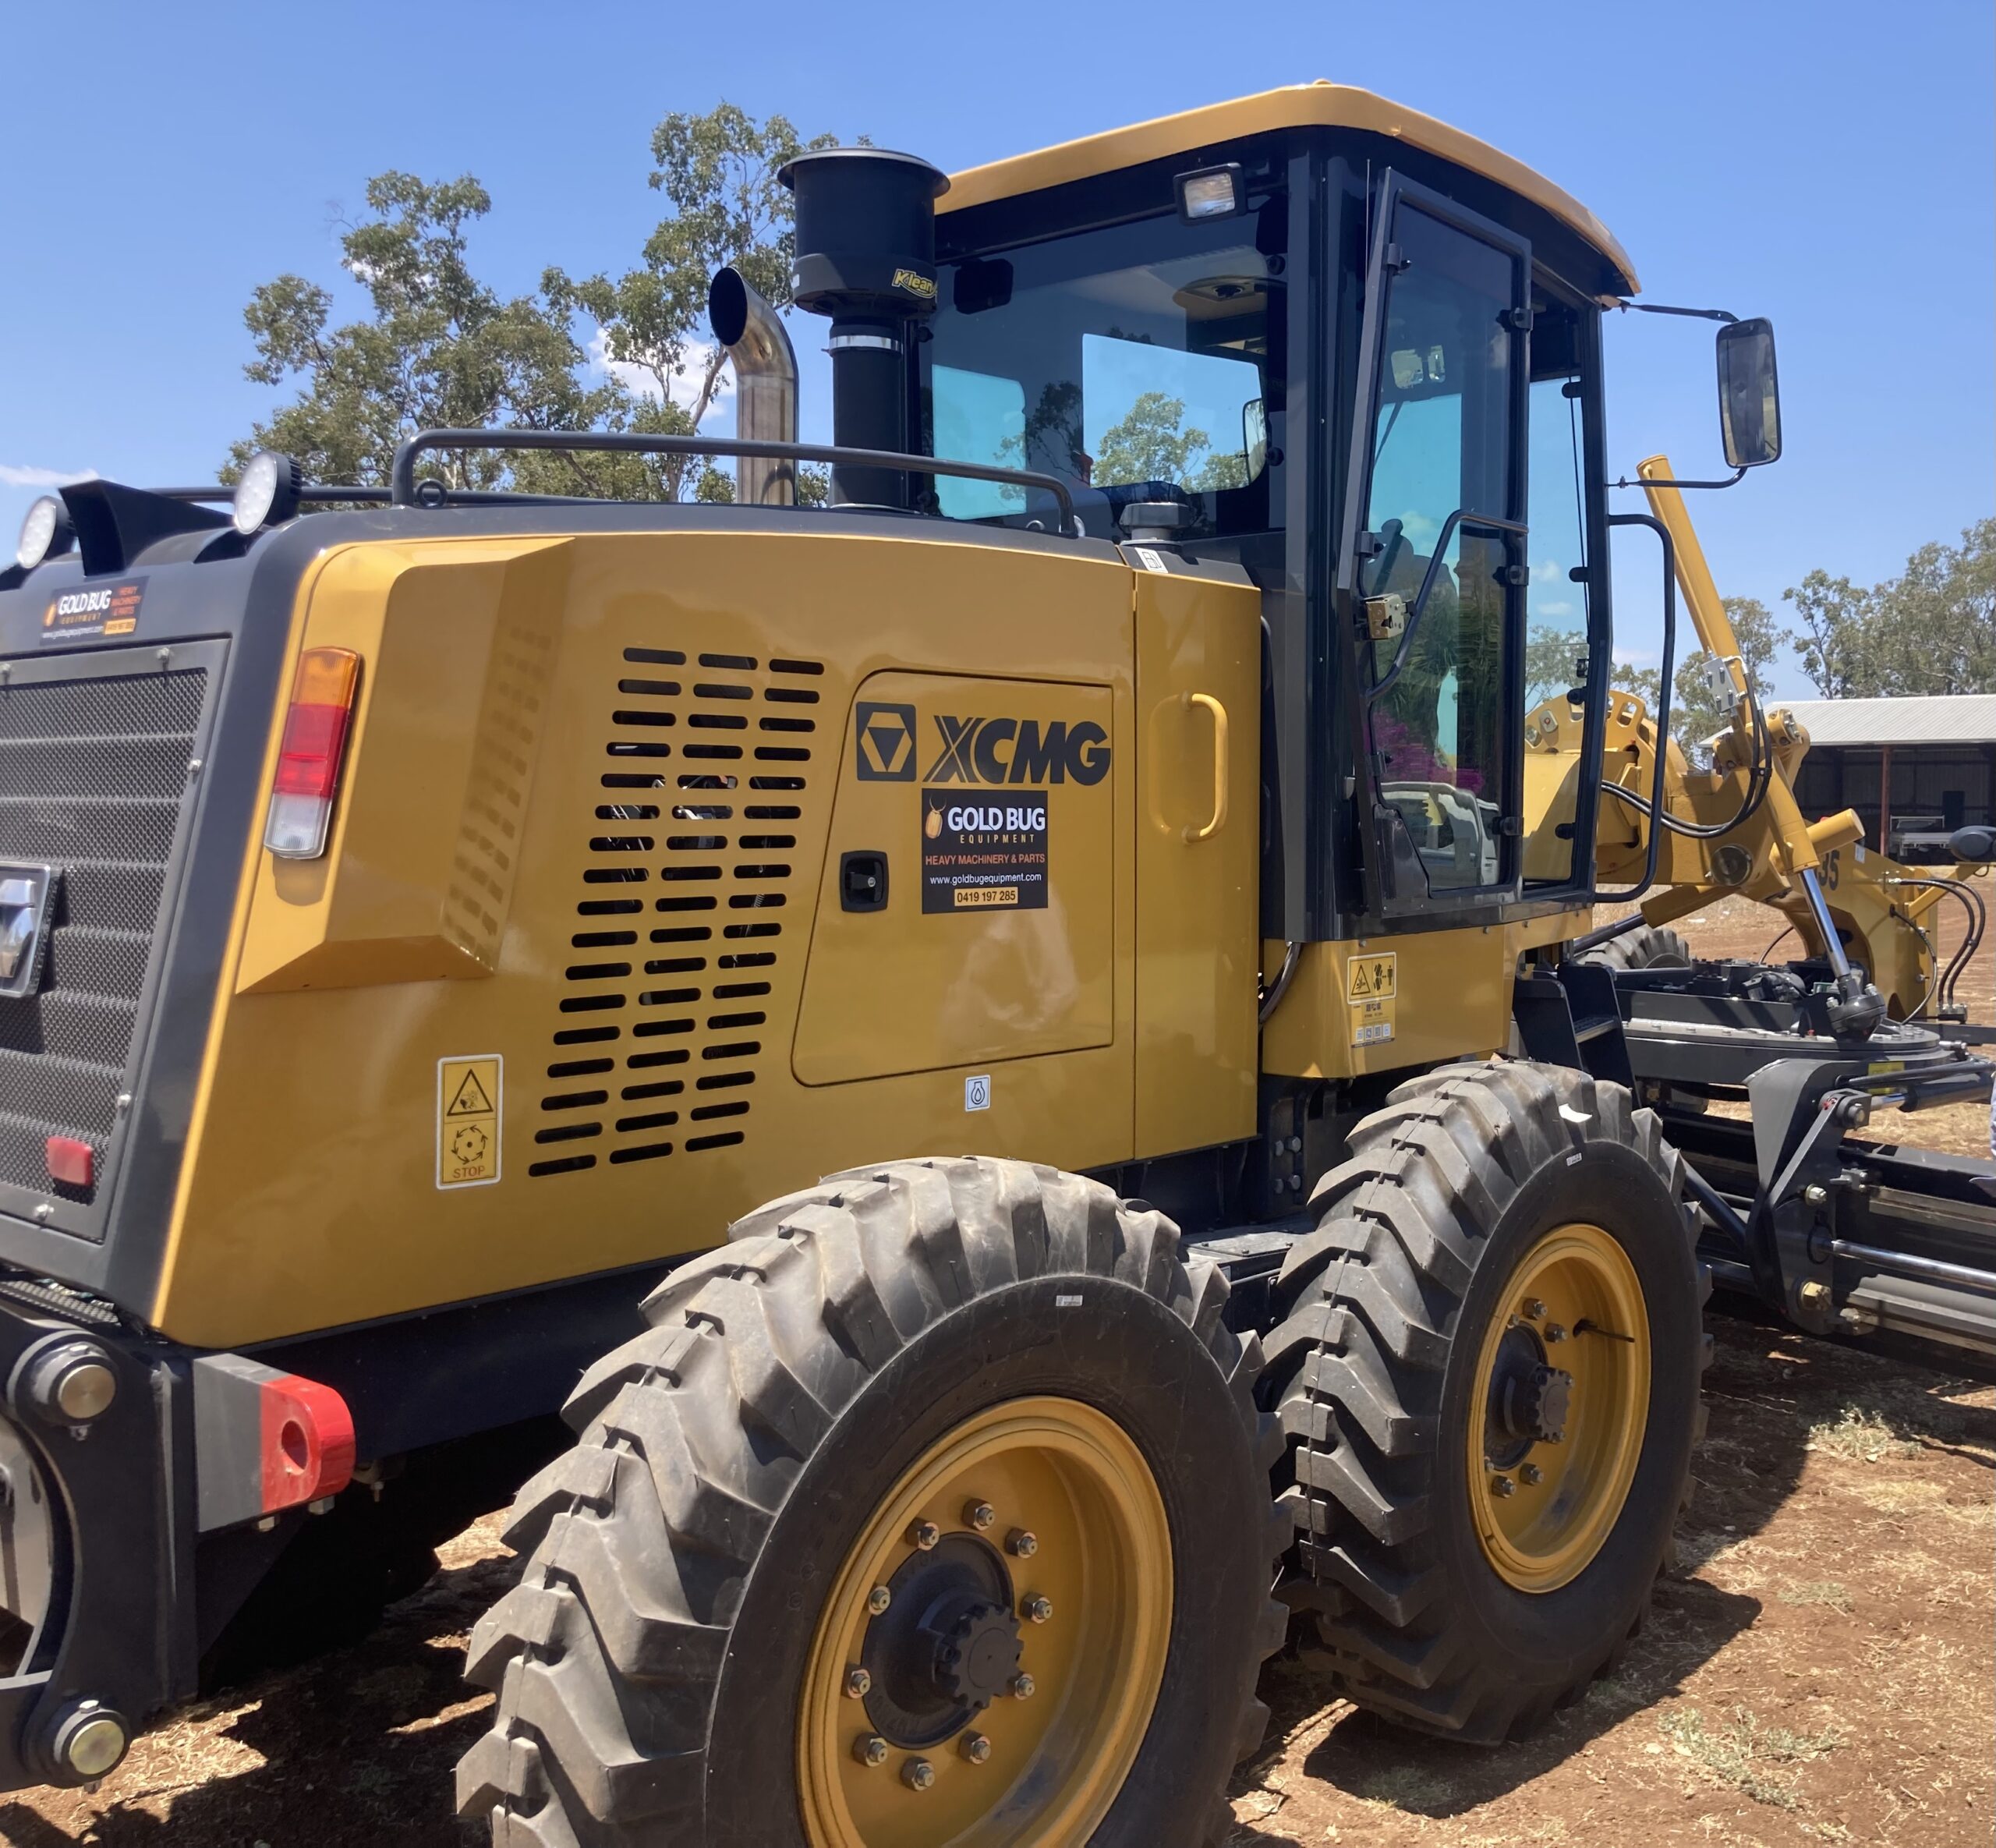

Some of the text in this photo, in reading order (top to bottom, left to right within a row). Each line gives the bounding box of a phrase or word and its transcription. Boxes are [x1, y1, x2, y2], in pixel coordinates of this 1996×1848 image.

[893, 269, 933, 293] Klean
[58, 589, 112, 615] GOLD BUG
[922, 715, 1111, 786] XCMG
[947, 807, 1046, 831] GOLD BUG
[960, 834, 1035, 844] EQUIPMENT
[925, 854, 1046, 866] HEAVY MACHINERY & PARTS
[930, 873, 1042, 886] www.goldbugequipment.com
[957, 890, 1016, 903] 0419 197 285
[453, 1165, 485, 1179] STOP
